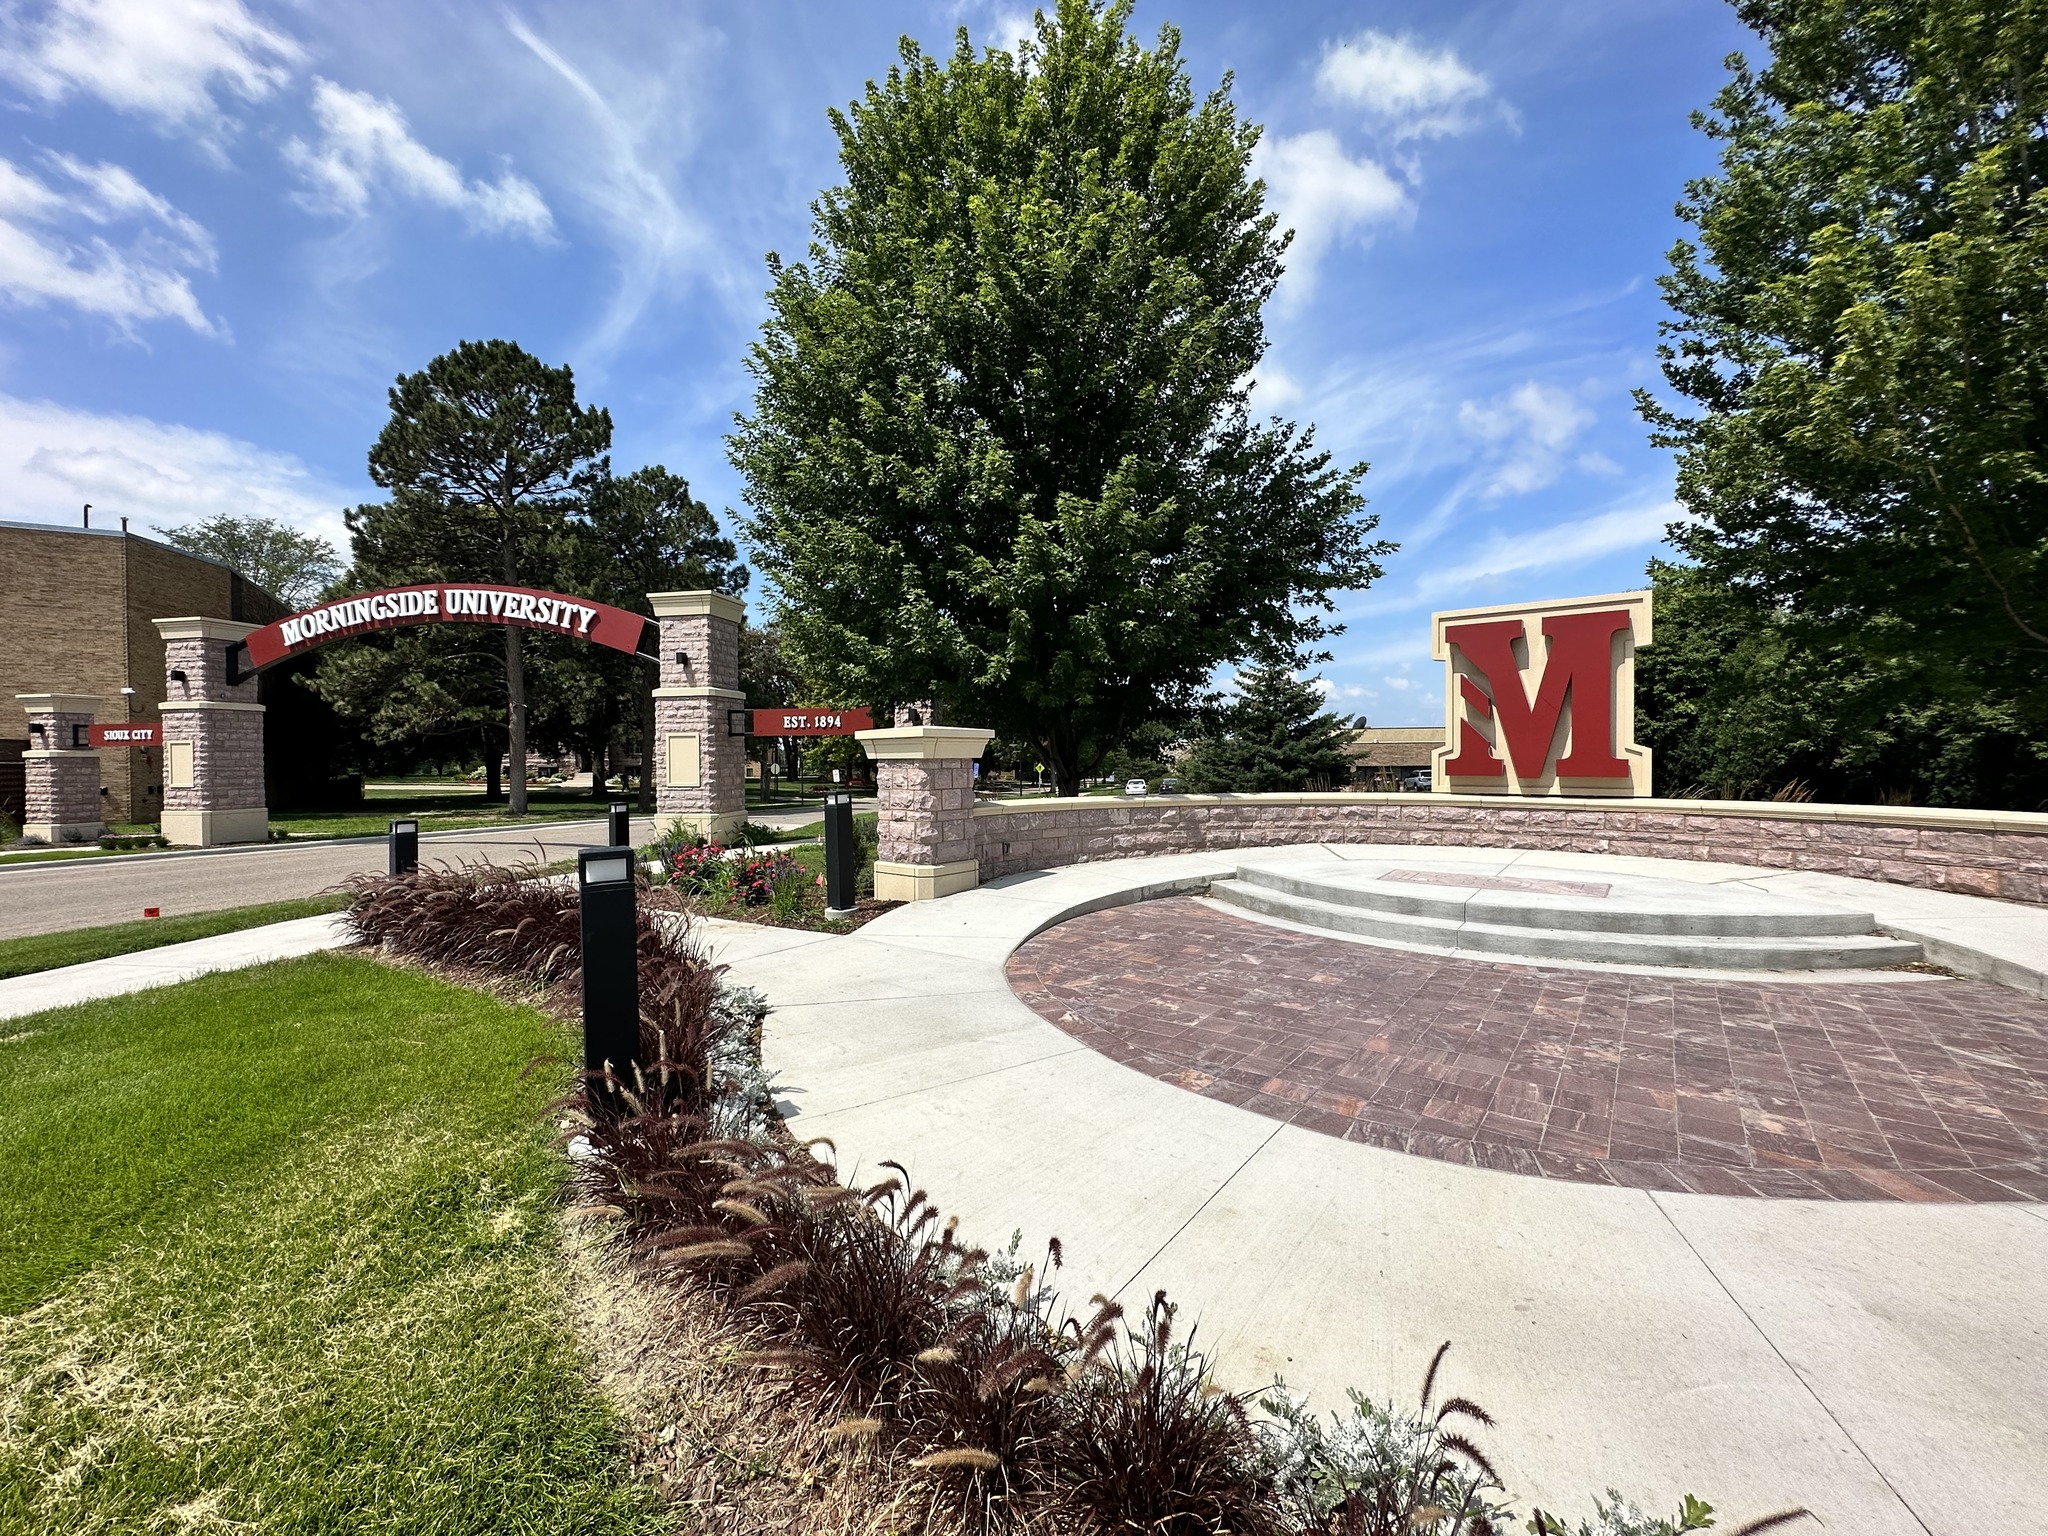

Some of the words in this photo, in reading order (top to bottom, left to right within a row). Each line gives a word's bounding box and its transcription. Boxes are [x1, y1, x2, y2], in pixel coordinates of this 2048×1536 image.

[279, 589, 438, 646] MORNINGSIDE
[443, 589, 597, 633] UNIVERSITY
[1445, 609, 1630, 779] M
[103, 730, 130, 741] SIOUX
[132, 729, 153, 740] CITY
[783, 715, 811, 728] EST.
[814, 715, 841, 728] 1894
